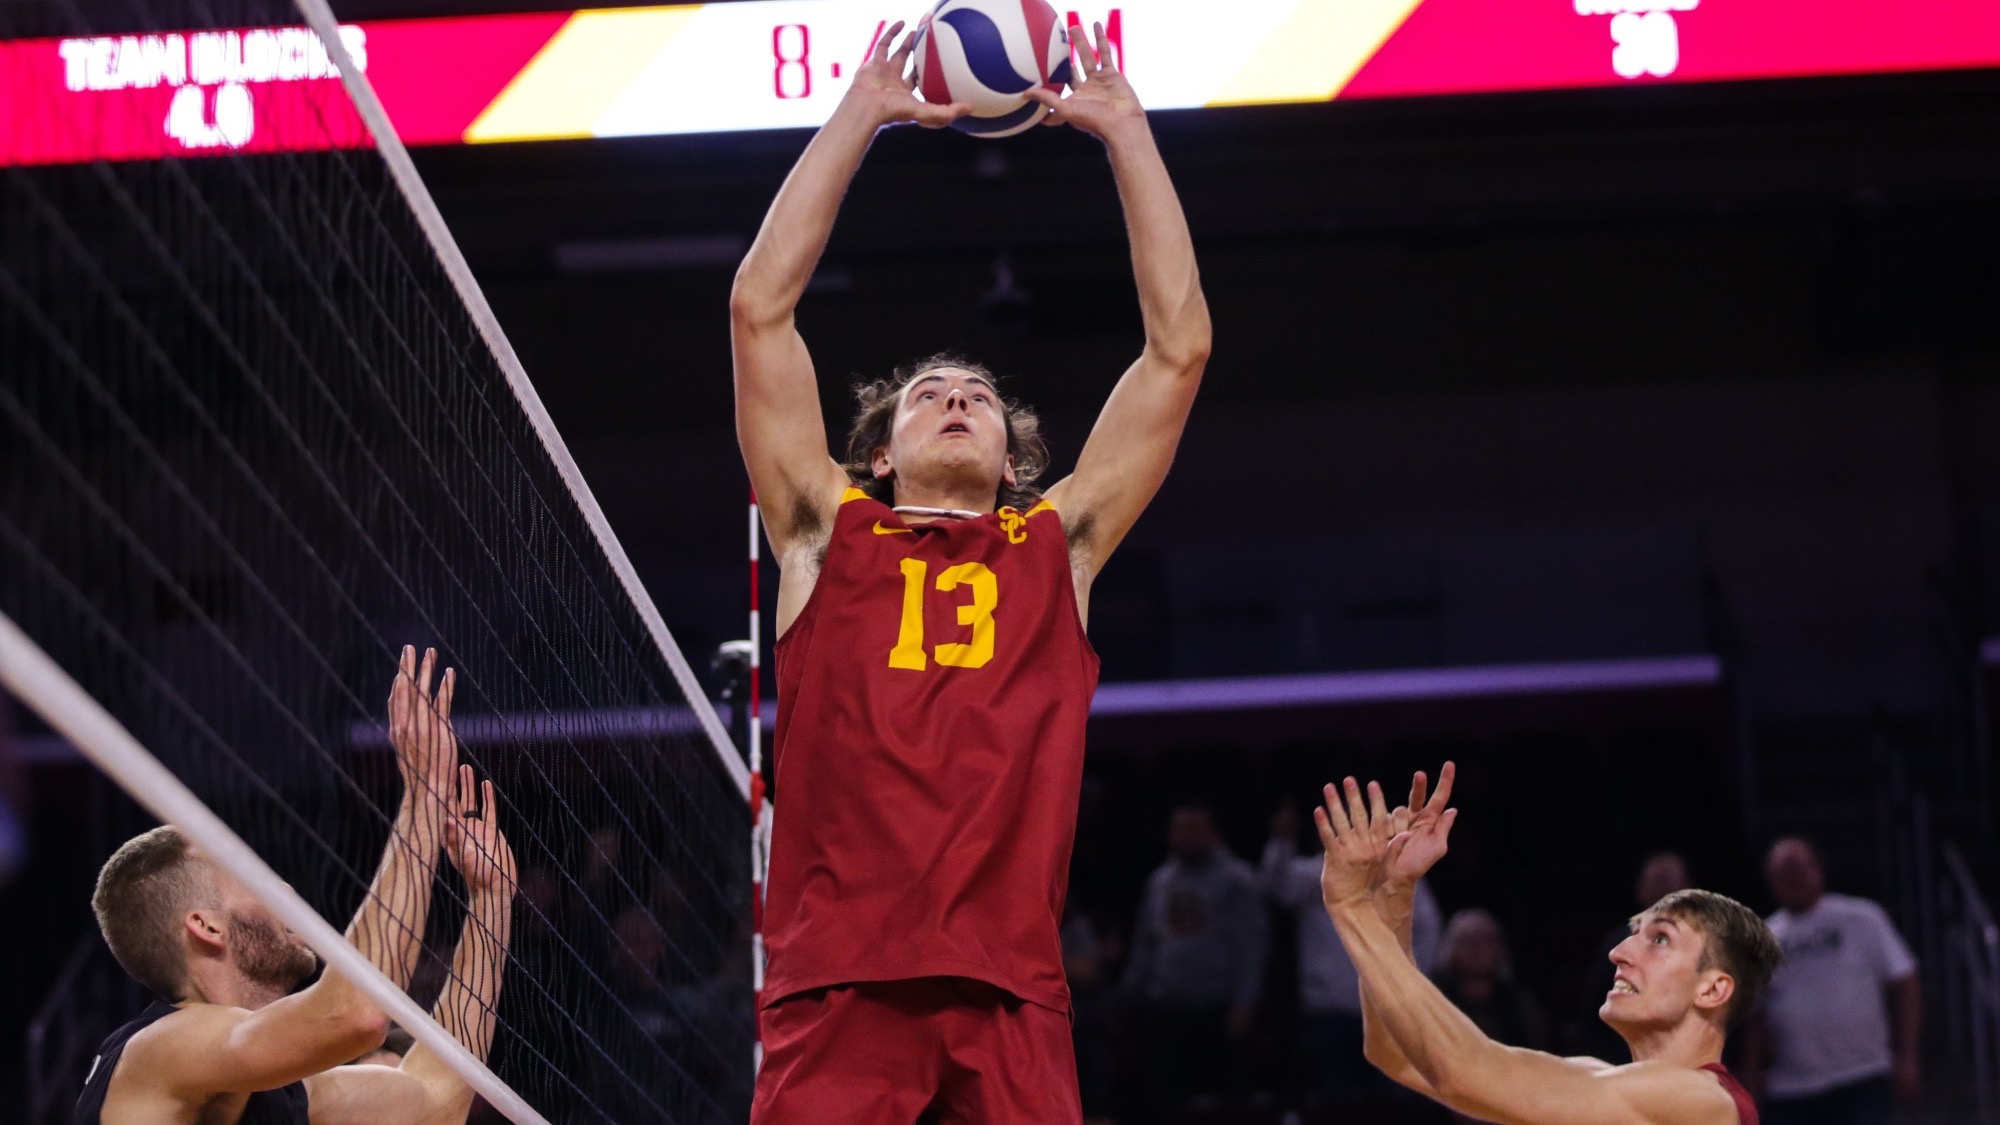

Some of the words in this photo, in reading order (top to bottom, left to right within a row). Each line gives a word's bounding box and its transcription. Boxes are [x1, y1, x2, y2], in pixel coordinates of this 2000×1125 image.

[60, 34, 185, 91] TEAM
[998, 506, 1027, 544] SC
[888, 557, 998, 671] 13
